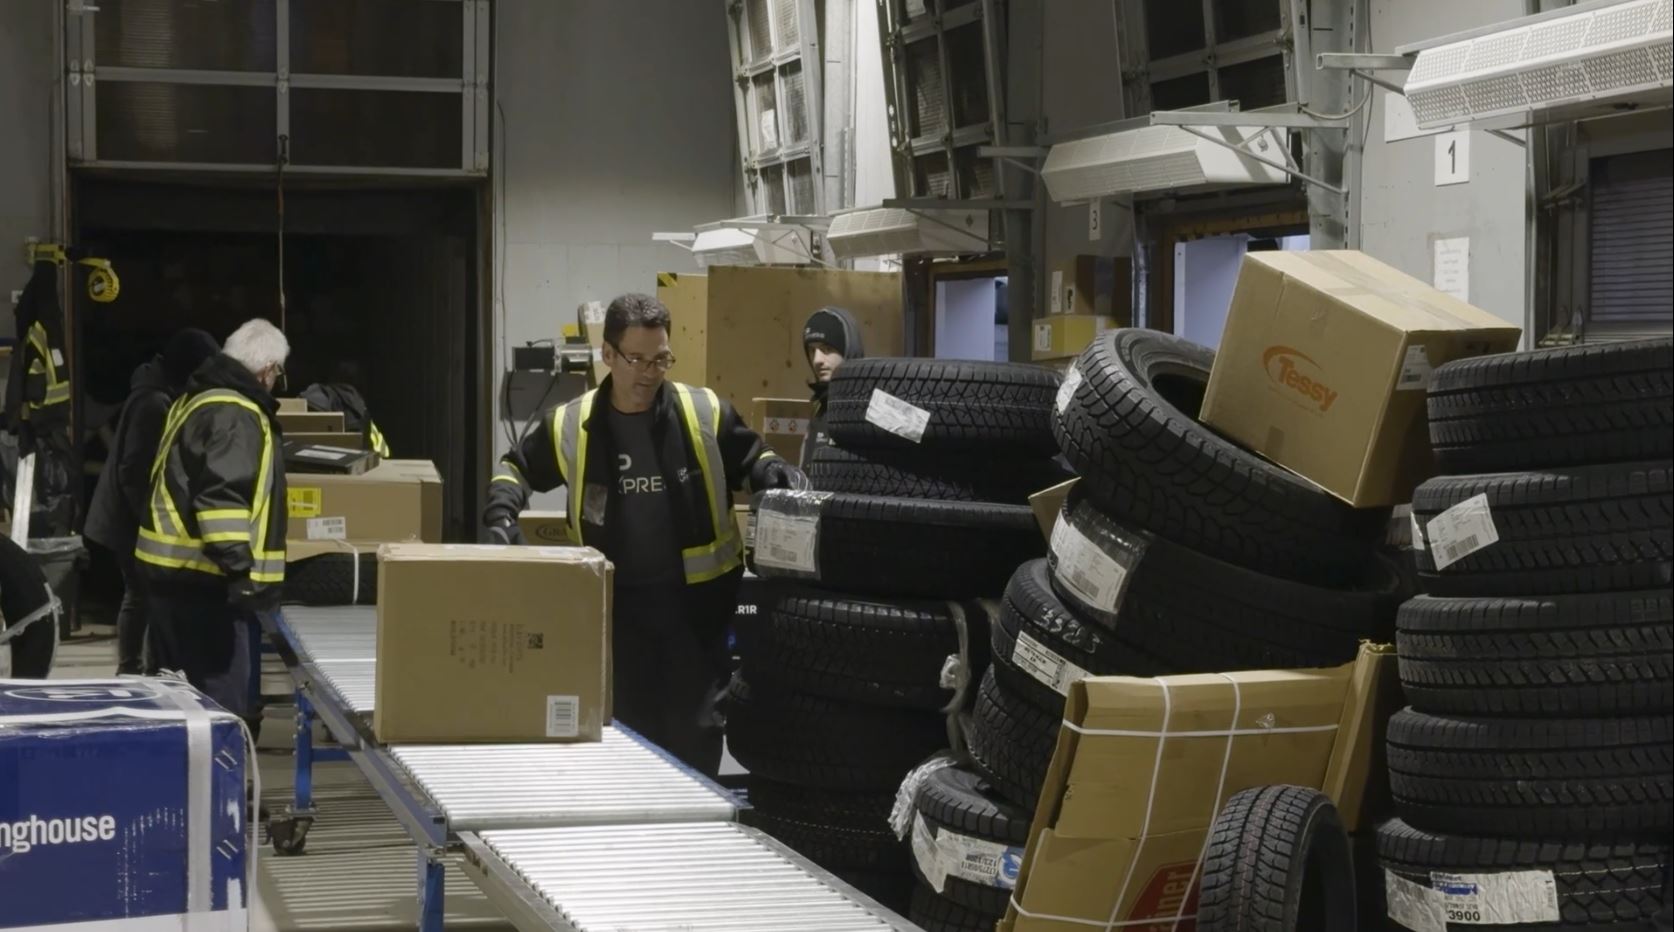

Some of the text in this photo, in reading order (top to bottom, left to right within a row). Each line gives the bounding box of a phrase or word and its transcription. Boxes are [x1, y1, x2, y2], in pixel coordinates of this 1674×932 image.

[1448, 140, 1456, 174] 1
[1091, 209, 1099, 230] 3
[1279, 355, 1338, 412] Tessy
[0, 814, 116, 853] nghouse
